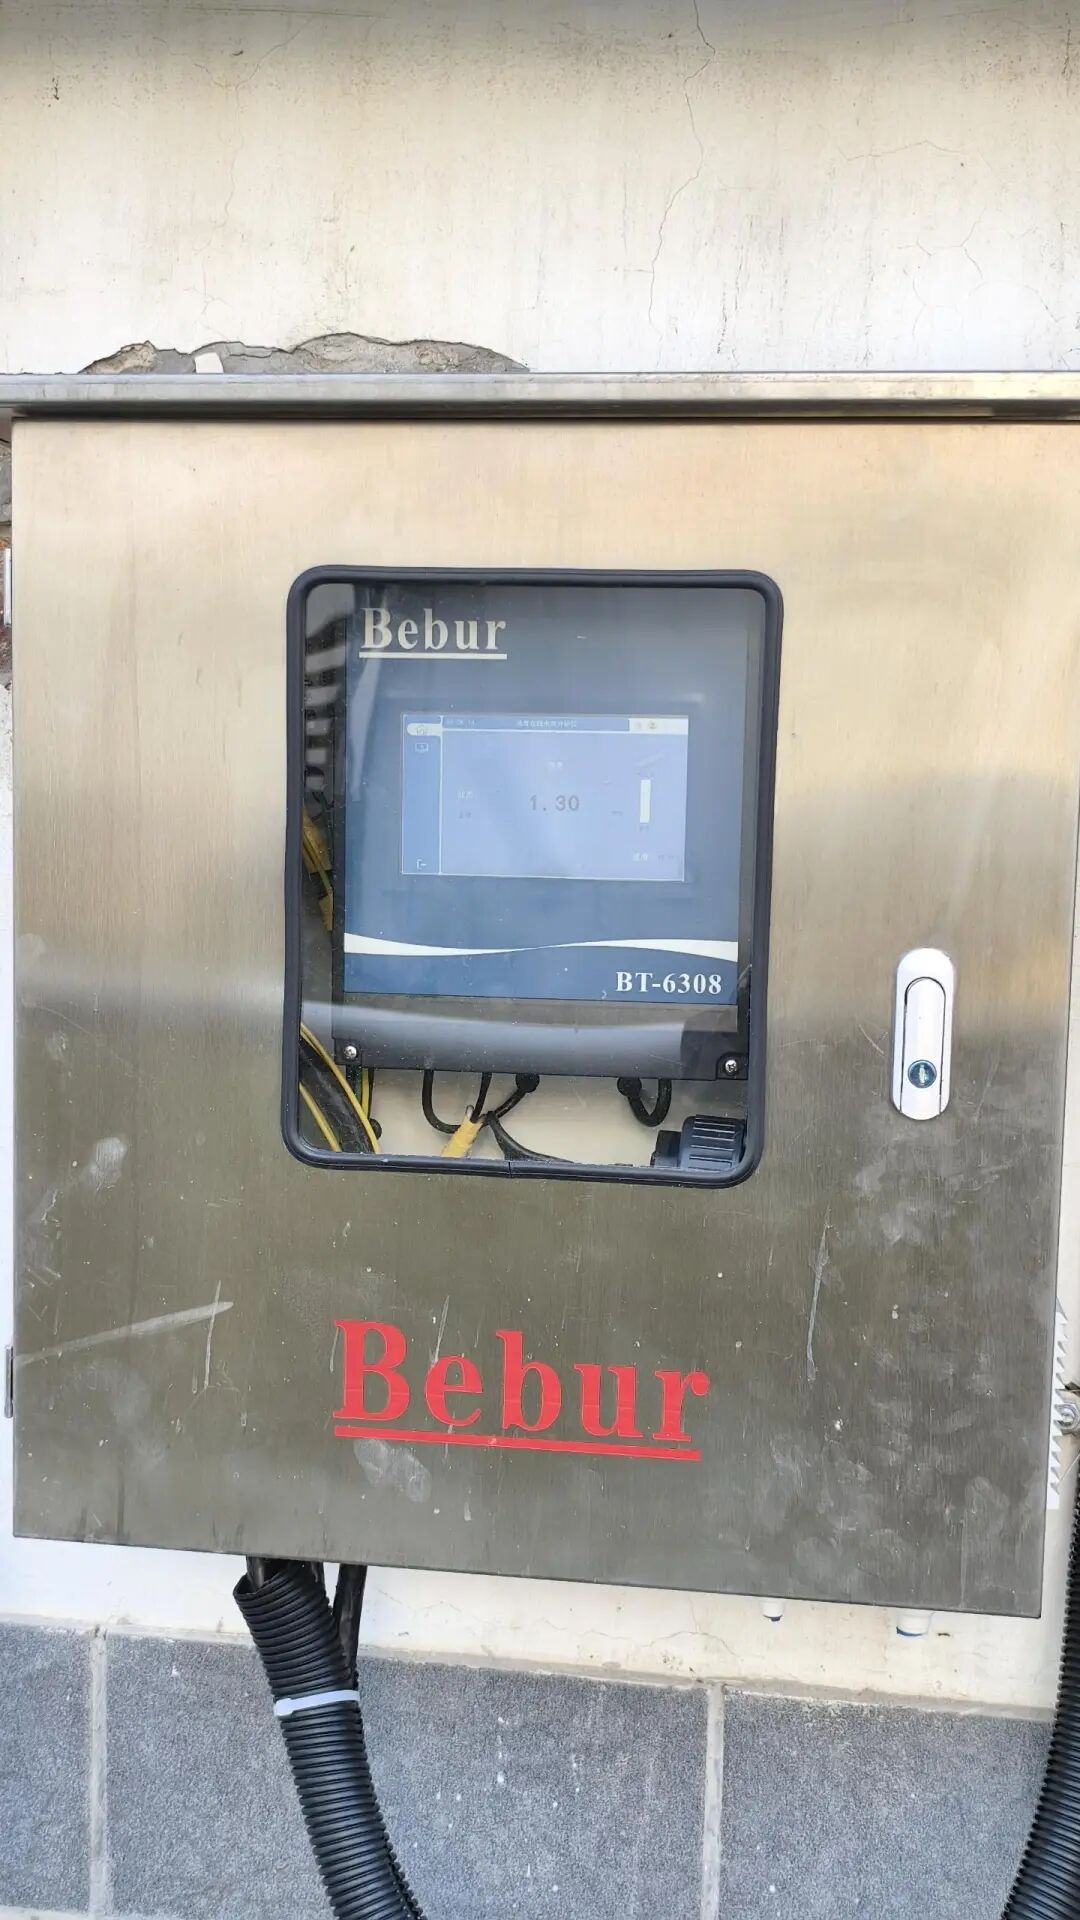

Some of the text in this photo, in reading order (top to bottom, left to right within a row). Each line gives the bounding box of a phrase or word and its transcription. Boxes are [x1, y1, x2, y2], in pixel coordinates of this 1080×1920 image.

[361, 607, 507, 650] Bebur
[529, 794, 580, 812] 1.30
[615, 971, 722, 995] BT-6308
[332, 1319, 710, 1442] Bebur
